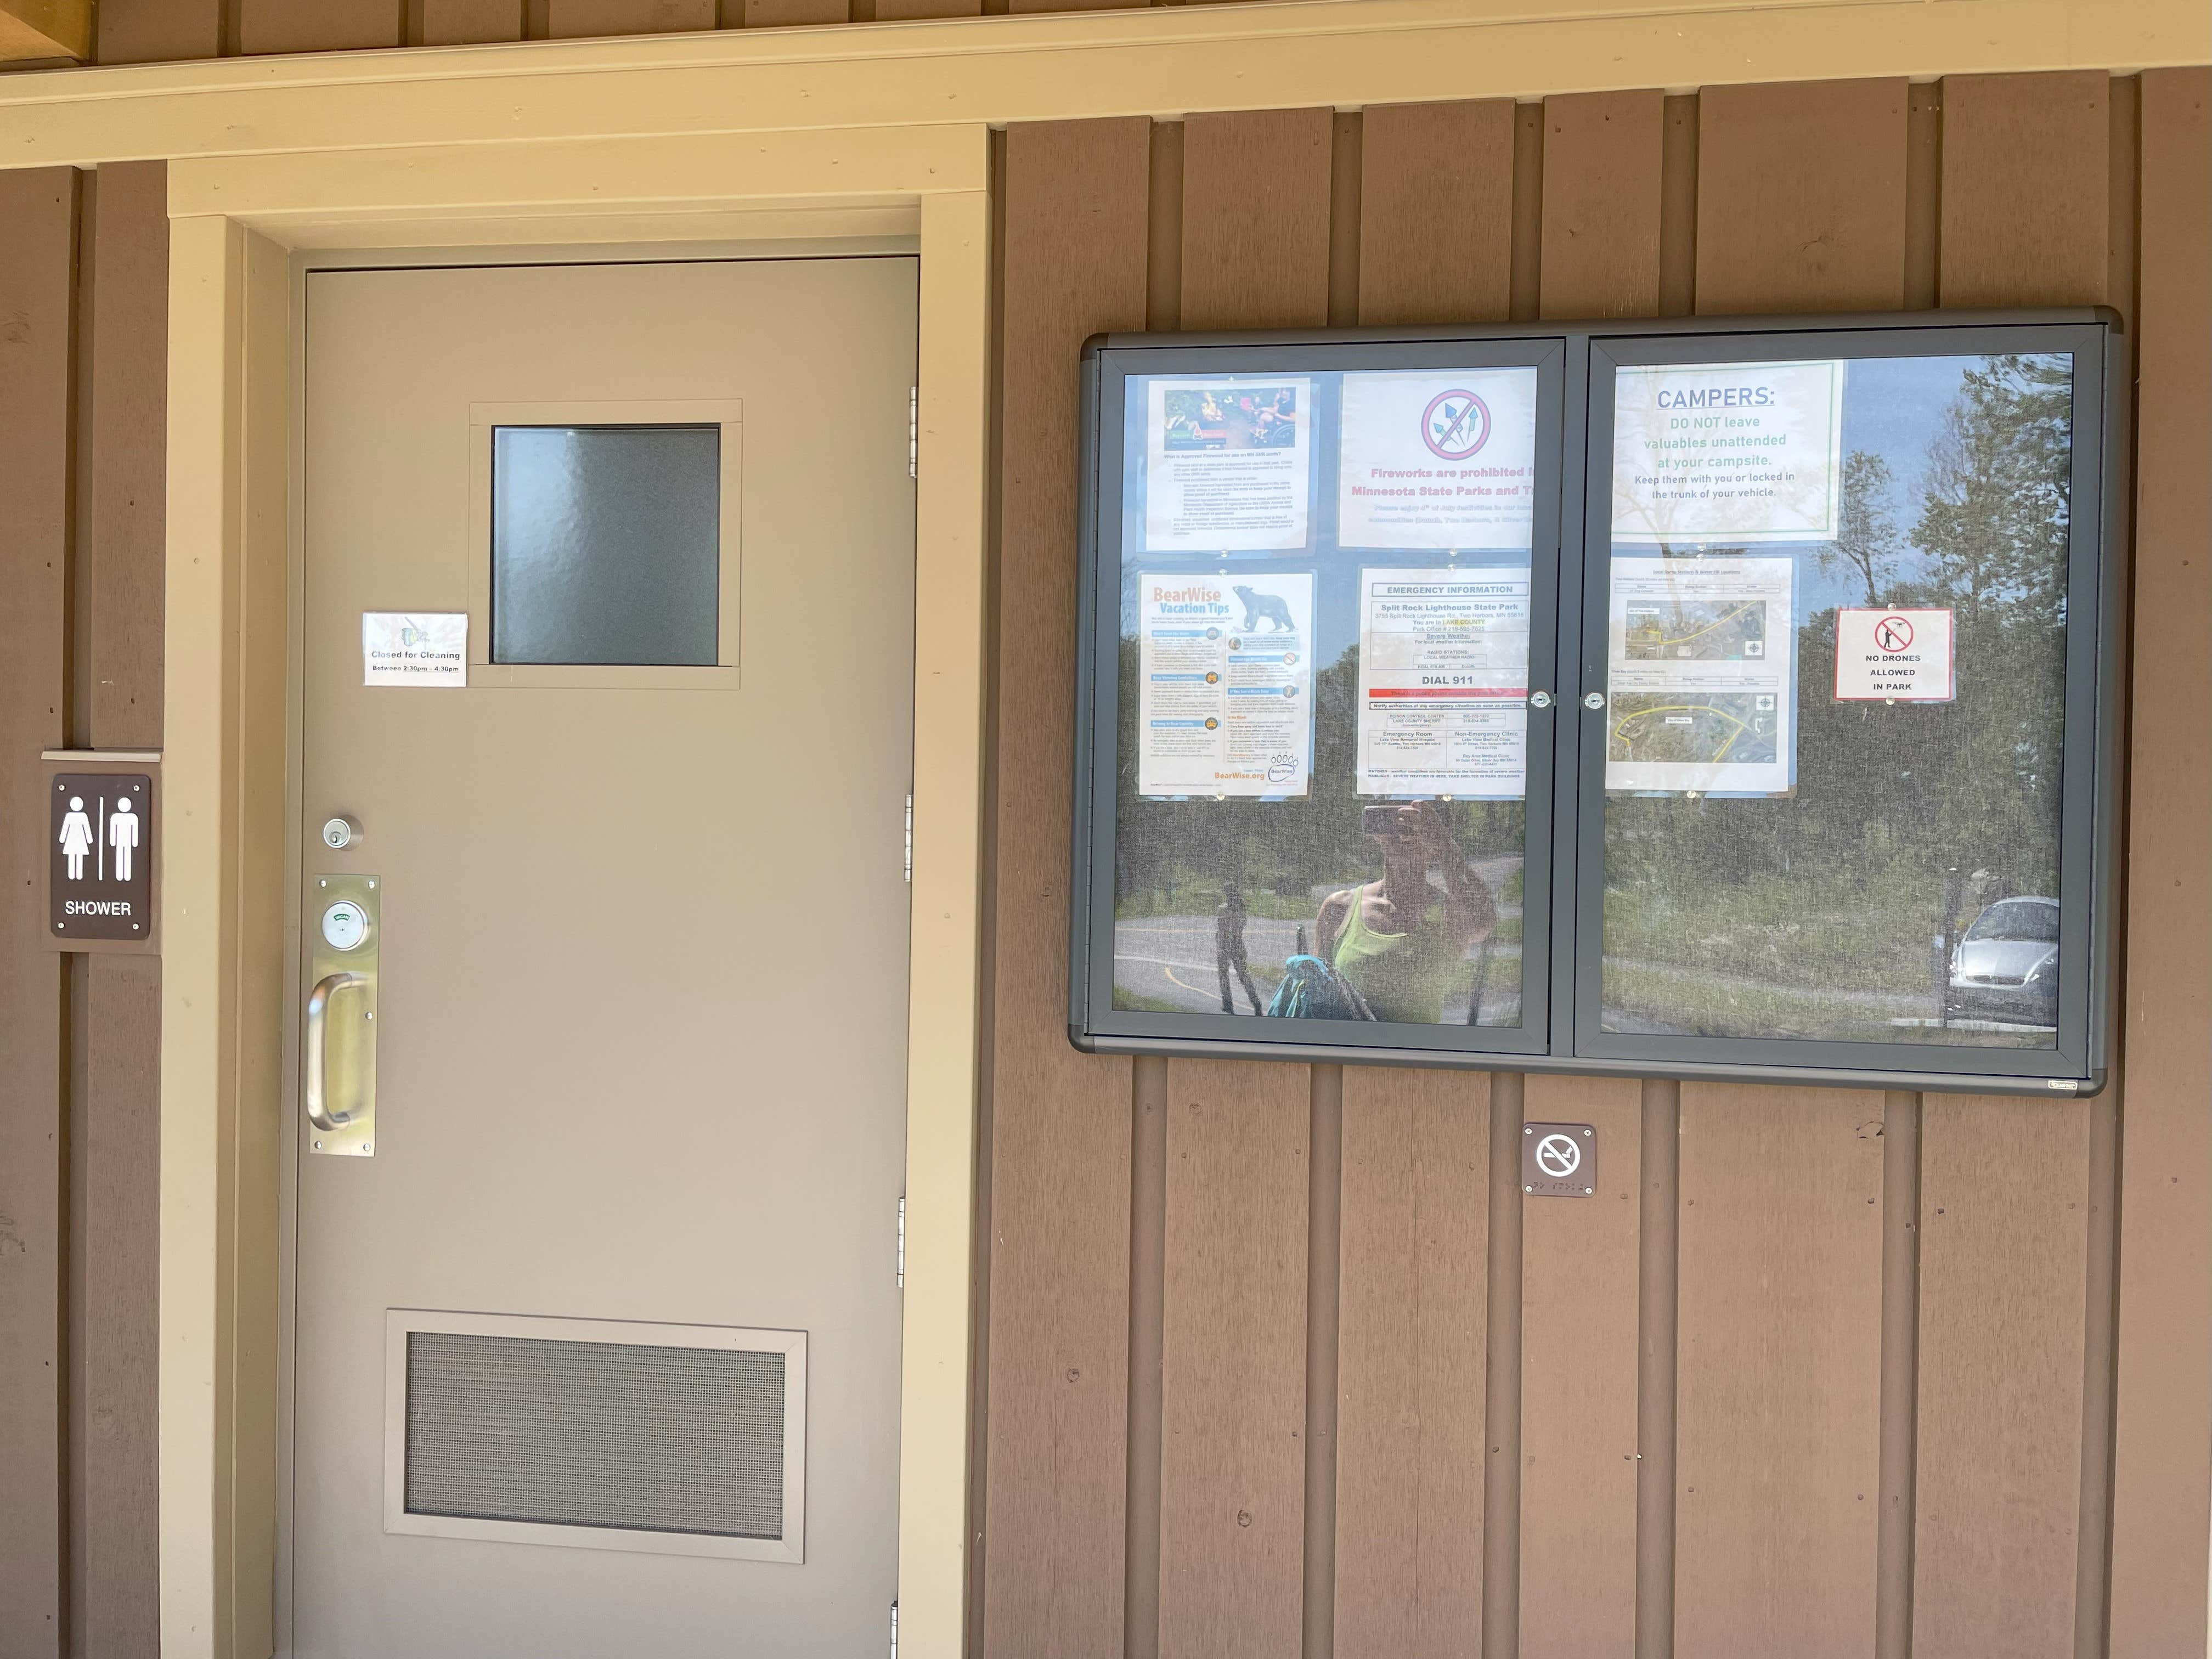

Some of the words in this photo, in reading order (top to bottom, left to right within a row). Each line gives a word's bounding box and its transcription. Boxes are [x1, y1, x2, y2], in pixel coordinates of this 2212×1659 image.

[1658, 387, 1775, 409] CAMPERS:
[1671, 417, 1689, 429] DO
[1694, 417, 1720, 428] NOT
[1725, 416, 1760, 427] leave
[1644, 437, 1707, 449] valuables
[1712, 434, 1786, 448] unattended
[1658, 458, 1669, 468] at
[1674, 458, 1703, 470] your
[1707, 455, 1772, 470] campsite.
[1371, 469, 1432, 478] Fireworks
[1460, 467, 1524, 479] prohibited
[1635, 476, 1659, 486] Keep
[1662, 475, 1687, 484] them
[1691, 474, 1711, 483] with
[1714, 475, 1732, 485] you
[1750, 472, 1782, 482] locked
[1786, 472, 1795, 481] in
[1352, 486, 1415, 496] Minnesota
[1419, 486, 1453, 496] State
[1457, 486, 1492, 495] Parks
[1496, 486, 1519, 495] and
[1652, 490, 1667, 499] the
[1671, 489, 1697, 499] trunk
[1700, 489, 1709, 498] of
[1713, 490, 1735, 500] your
[1739, 488, 1776, 498] vehicle.
[1154, 587, 1221, 602] BearWise
[1160, 602, 1206, 613] Vacation
[1208, 602, 1229, 615] Tips
[1426, 604, 1471, 612] Lighthouse
[420, 651, 460, 660] Cleaning
[65, 901, 131, 916] SHOWER
